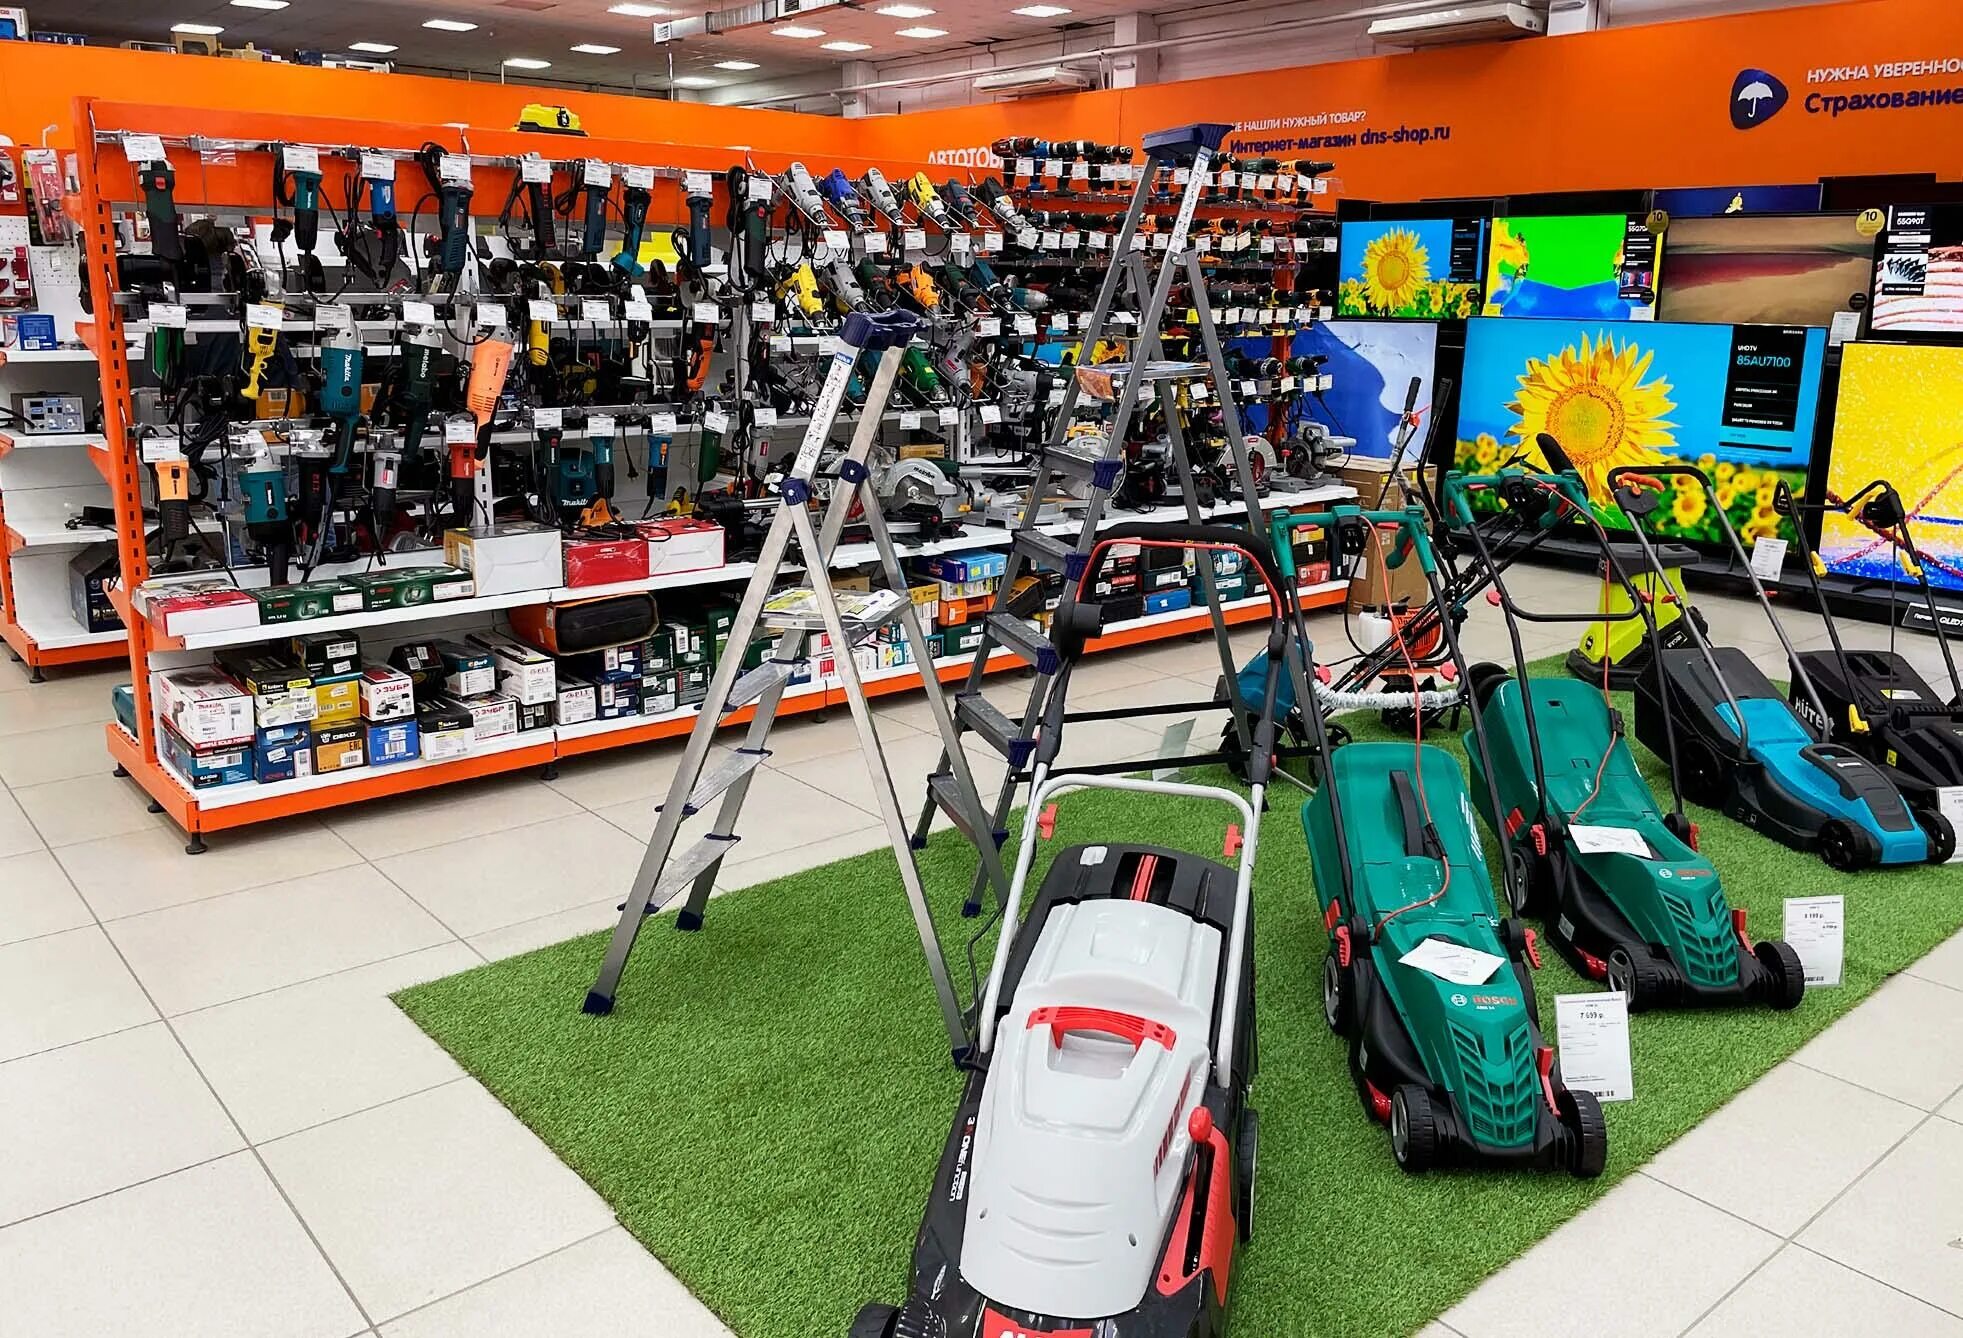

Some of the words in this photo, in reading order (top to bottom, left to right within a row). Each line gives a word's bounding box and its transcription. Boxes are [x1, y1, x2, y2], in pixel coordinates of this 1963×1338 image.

[1807, 66, 1869, 83] НУЖНА
[1873, 57, 1963, 79] УВЕРЕННО
[1804, 86, 1963, 118] Страхование
[1244, 118, 1281, 132] НАШЛИ
[1282, 112, 1327, 128] НУЖНЫЙ
[1329, 109, 1367, 125] ТОВАР?
[1230, 131, 1356, 155] Интернет-магазин
[1360, 125, 1451, 146] dns-shop.ru
[1865, 211, 1878, 221] 10
[420, 348, 430, 379] metabo
[1736, 355, 1790, 367] 85AU7100
[561, 498, 588, 506] Makit
[382, 683, 410, 693] ЗУБР
[332, 731, 357, 741] DEKO
[1472, 995, 1518, 1006] BOSCH
